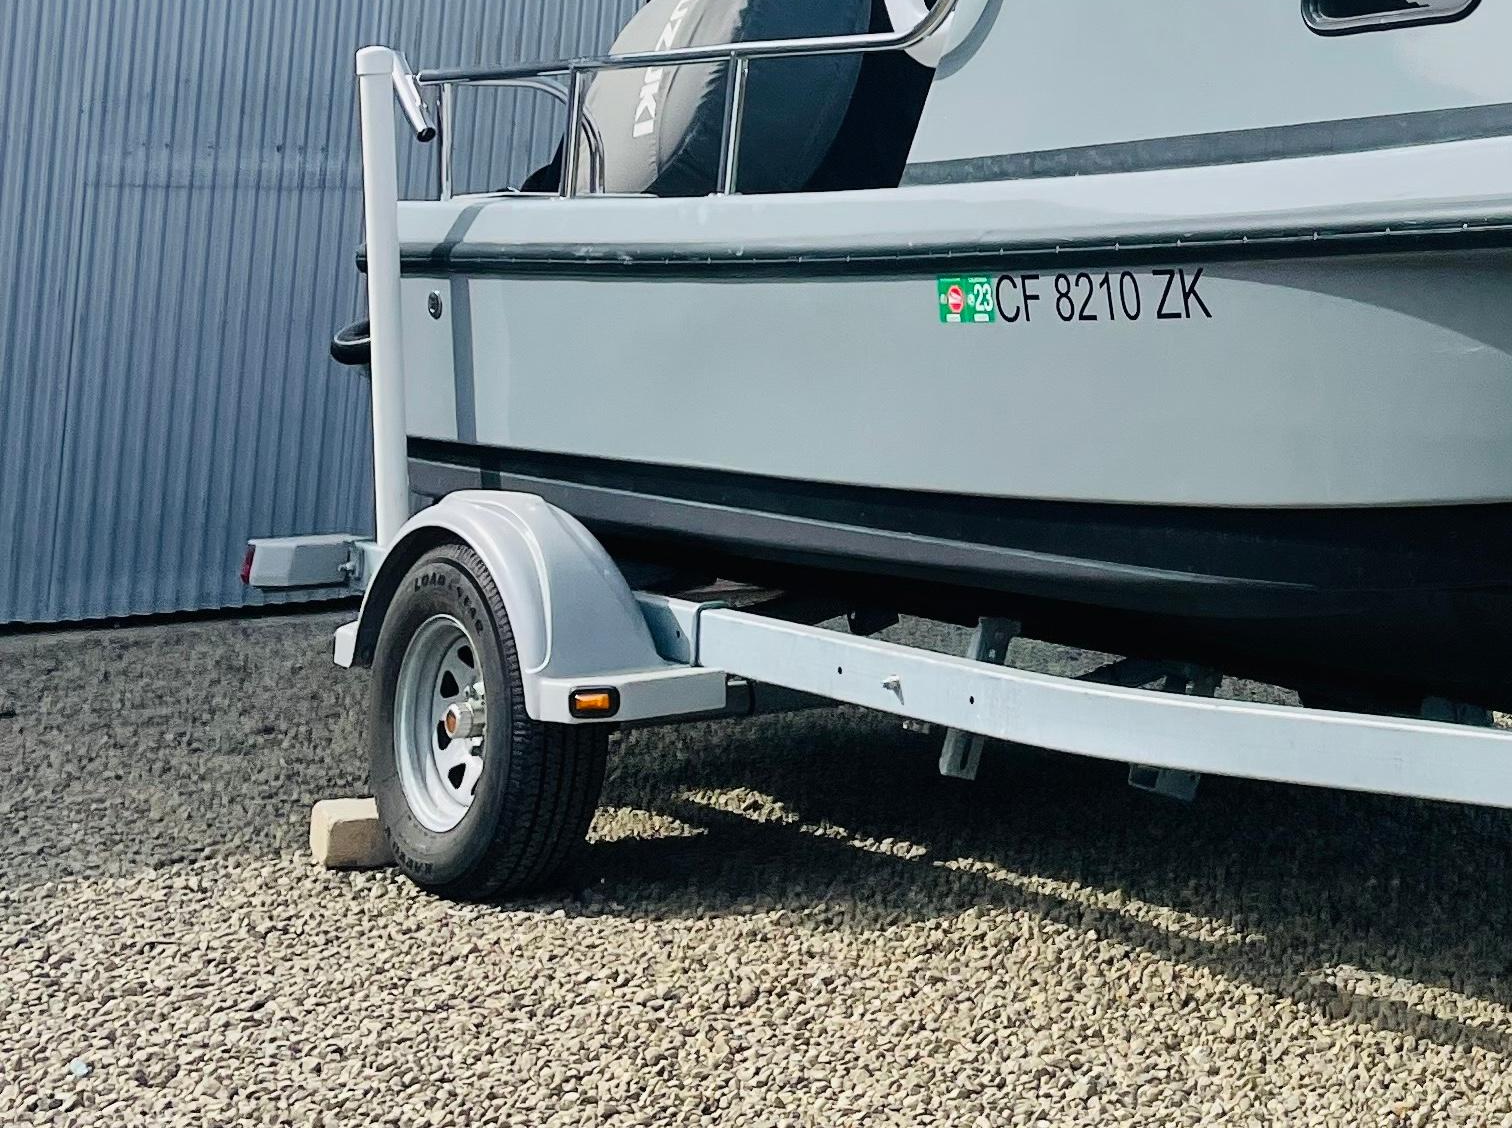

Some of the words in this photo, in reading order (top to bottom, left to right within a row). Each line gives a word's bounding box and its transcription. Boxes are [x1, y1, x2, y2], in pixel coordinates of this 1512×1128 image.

[973, 283, 994, 312] 23
[995, 274, 1040, 323] CF
[1054, 271, 1142, 322] 8210
[1151, 267, 1213, 319] ZK
